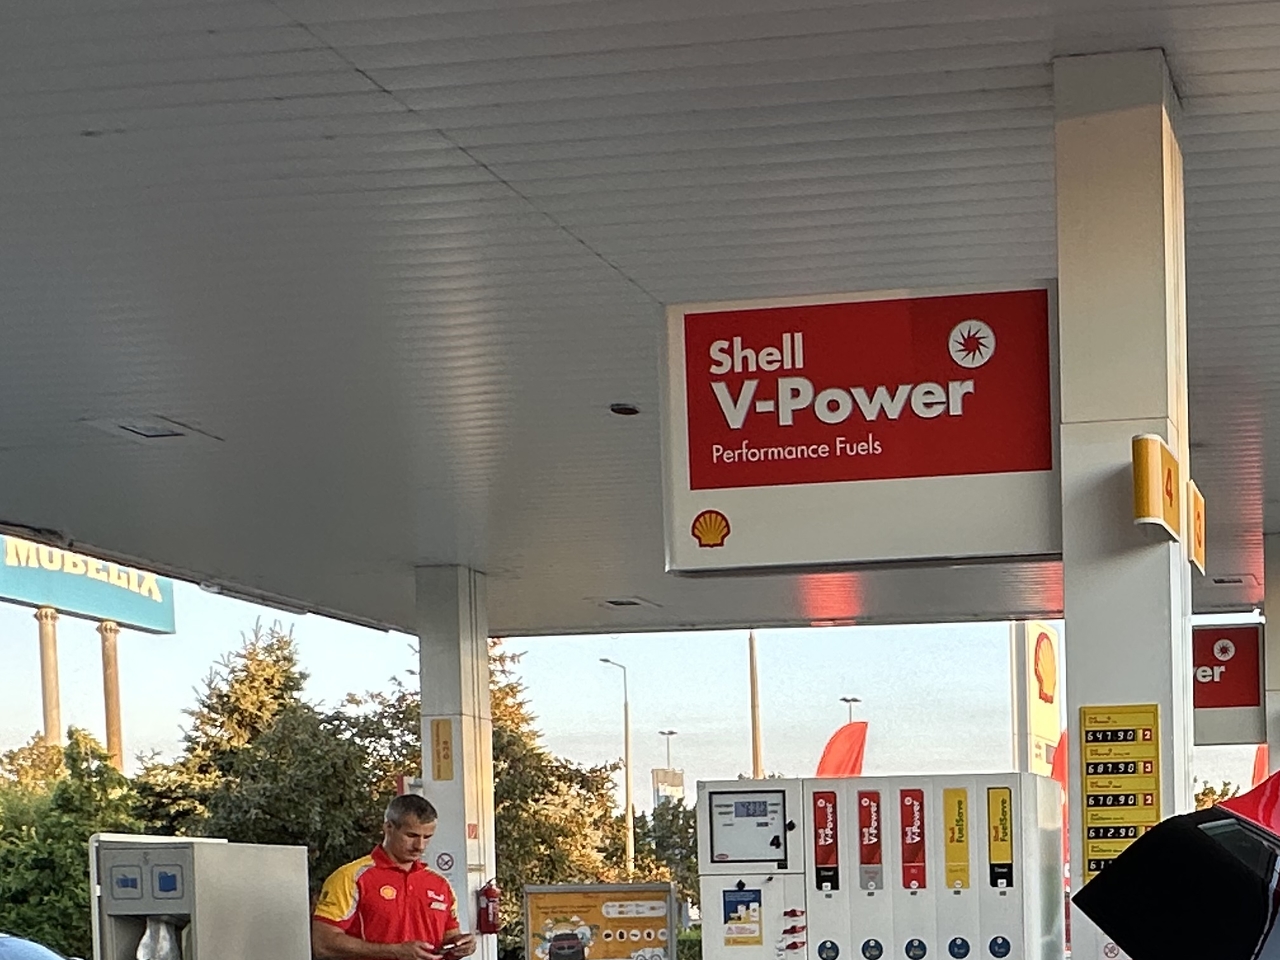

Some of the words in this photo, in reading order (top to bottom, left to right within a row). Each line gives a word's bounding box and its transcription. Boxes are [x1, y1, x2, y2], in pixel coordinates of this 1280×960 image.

[709, 332, 804, 374] Shell
[710, 377, 974, 429] V-Power
[712, 440, 830, 463] Performance
[836, 434, 882, 457] Fuels
[1165, 468, 1173, 508] 4
[1194, 665, 1226, 683] er
[1144, 730, 1151, 739] 2
[1145, 795, 1152, 804] 2
[956, 800, 964, 843] FuelSave
[999, 798, 1008, 842] FuelSave
[1089, 827, 1135, 838] 612.90
[769, 835, 781, 849] 4
